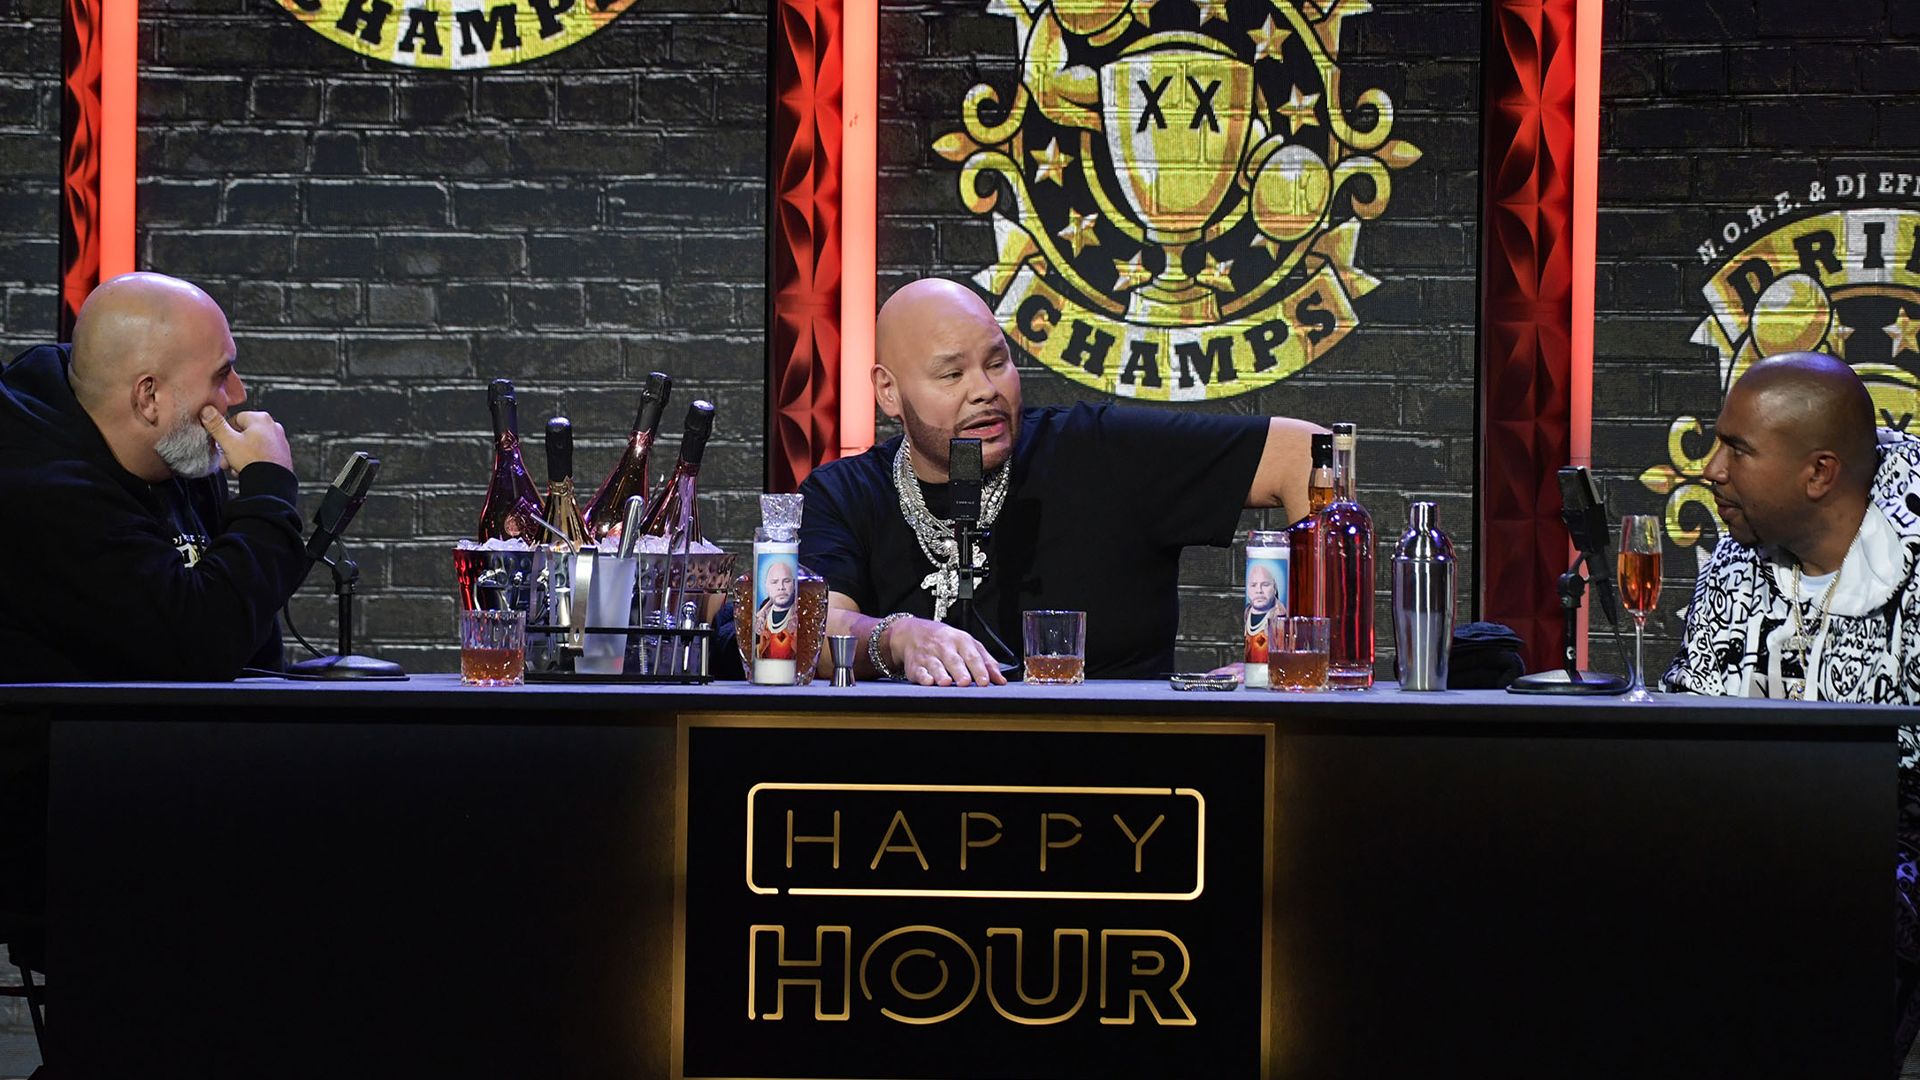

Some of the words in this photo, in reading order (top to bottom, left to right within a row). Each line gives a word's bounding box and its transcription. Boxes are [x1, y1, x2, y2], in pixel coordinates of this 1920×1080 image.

[1809, 181, 1827, 202] &
[1835, 171, 1867, 200] DJ
[1016, 295, 1337, 389] CHAMPS
[785, 809, 1166, 873] HAPPY
[748, 924, 1197, 1026] HOUR
